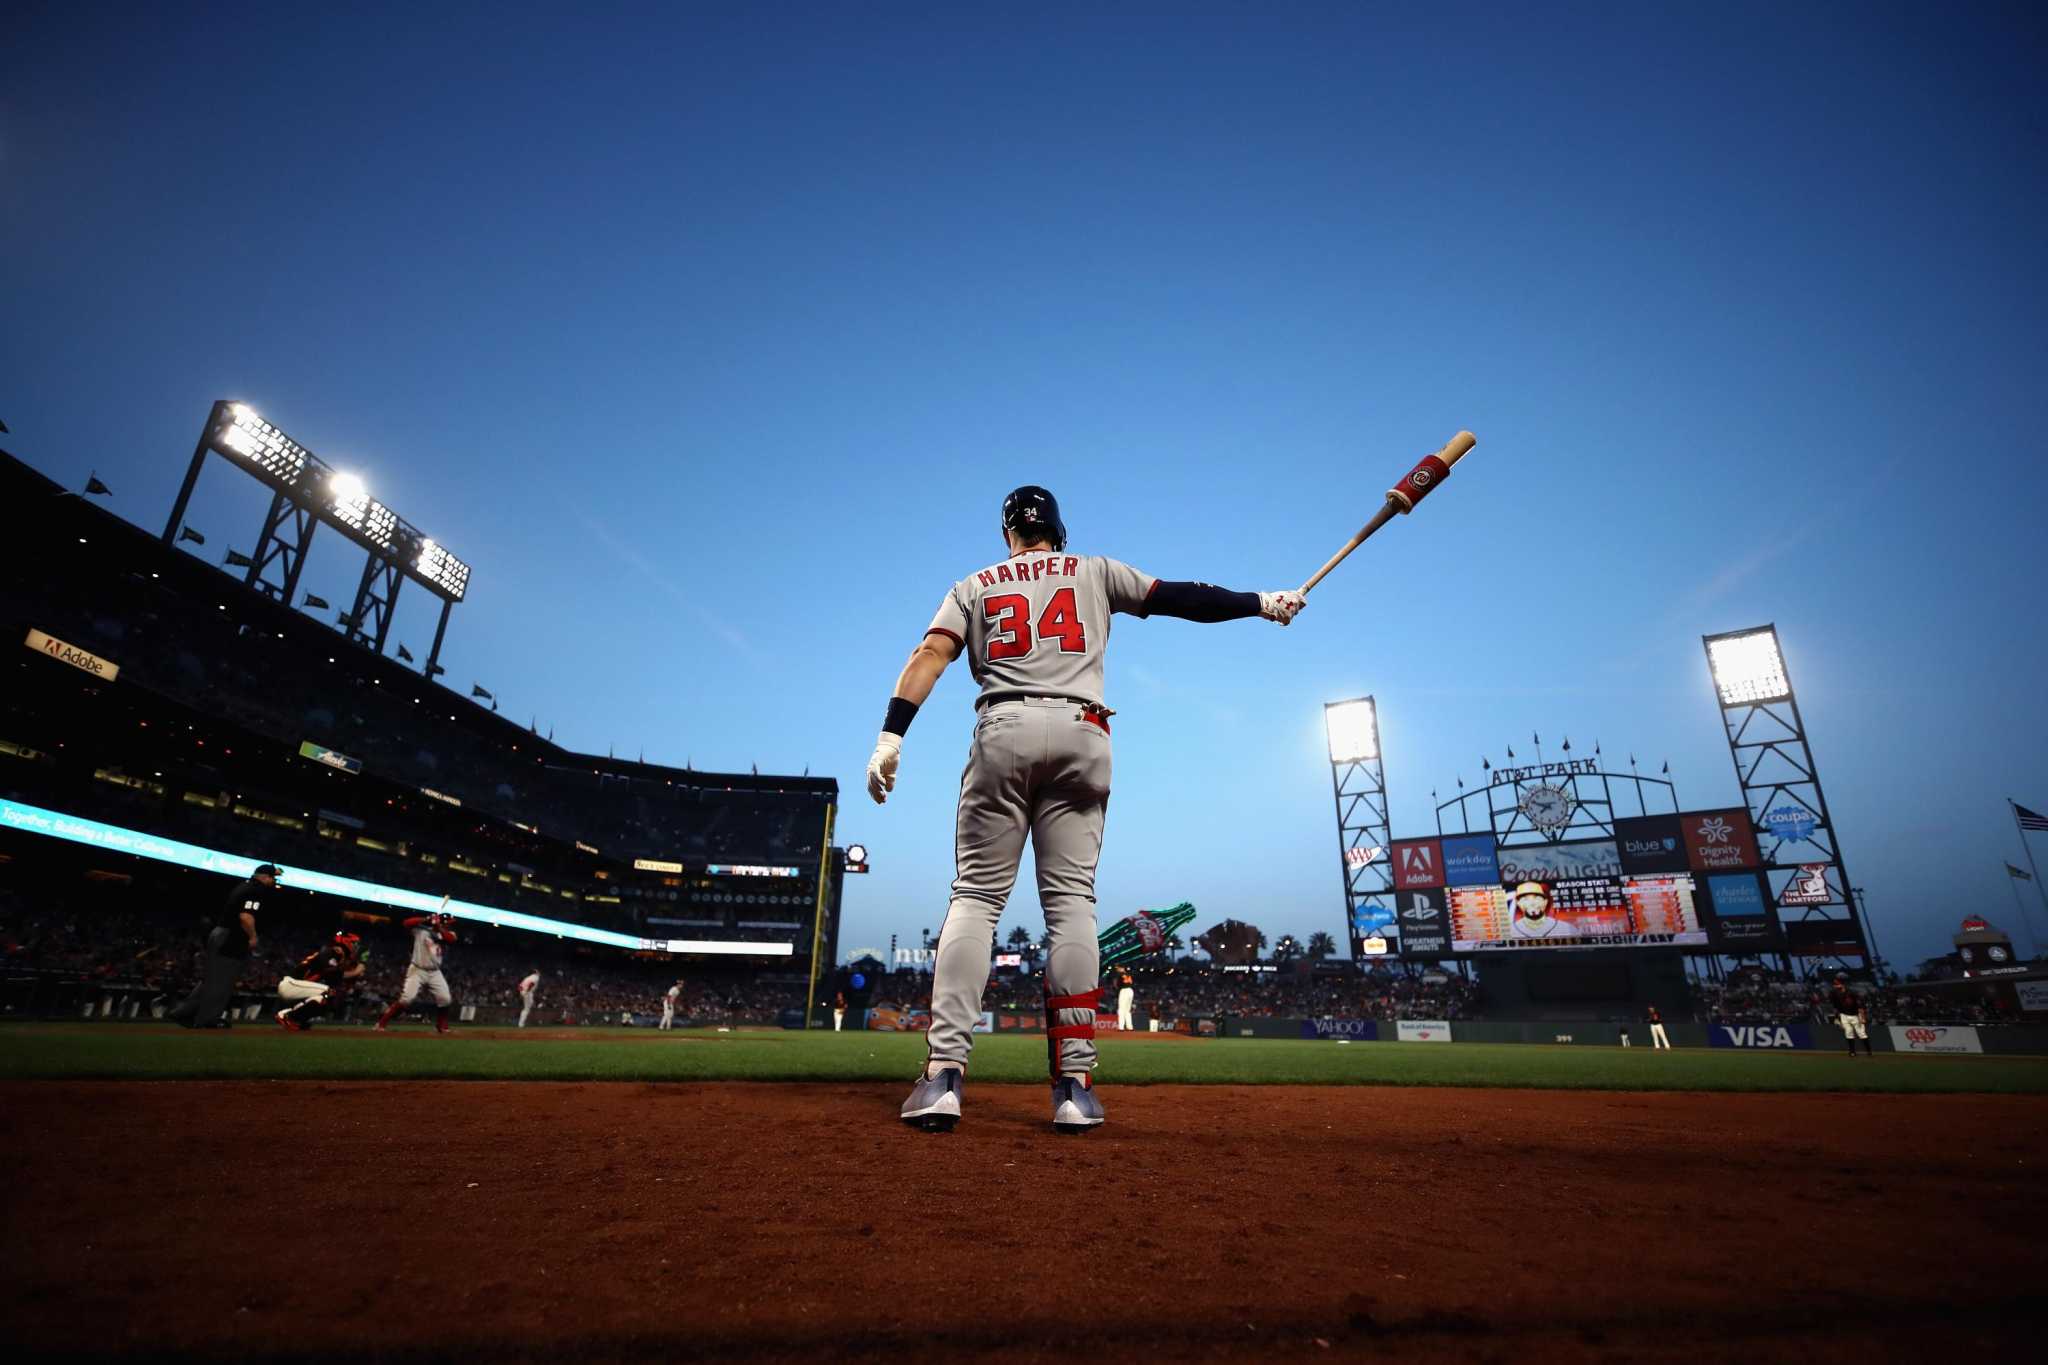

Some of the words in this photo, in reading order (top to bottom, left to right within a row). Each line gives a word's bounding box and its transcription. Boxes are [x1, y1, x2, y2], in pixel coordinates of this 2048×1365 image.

[1024, 507, 1037, 517] 34
[977, 556, 1079, 588] HARPER
[983, 587, 1087, 663] 34
[60, 647, 103, 674] Adobe
[1492, 766, 1535, 785] AT&T
[1544, 758, 1597, 775] PARK
[1769, 812, 1810, 824] coupa
[1625, 839, 1660, 852] blue
[1700, 846, 1740, 858] Dignity
[1447, 852, 1492, 864] workday
[1704, 858, 1743, 866] Health
[1501, 863, 1560, 882] Coors
[1561, 862, 1622, 880] LIGHT
[1406, 874, 1433, 884] Adobe
[1556, 880, 1586, 889] SEASON
[1587, 879, 1610, 887] STATS
[1093, 1020, 1119, 1030] YOTA
[1313, 1018, 1365, 1034] YAHOO!
[1721, 1026, 1795, 1047] VISA
[1906, 1029, 1936, 1043] AAA
